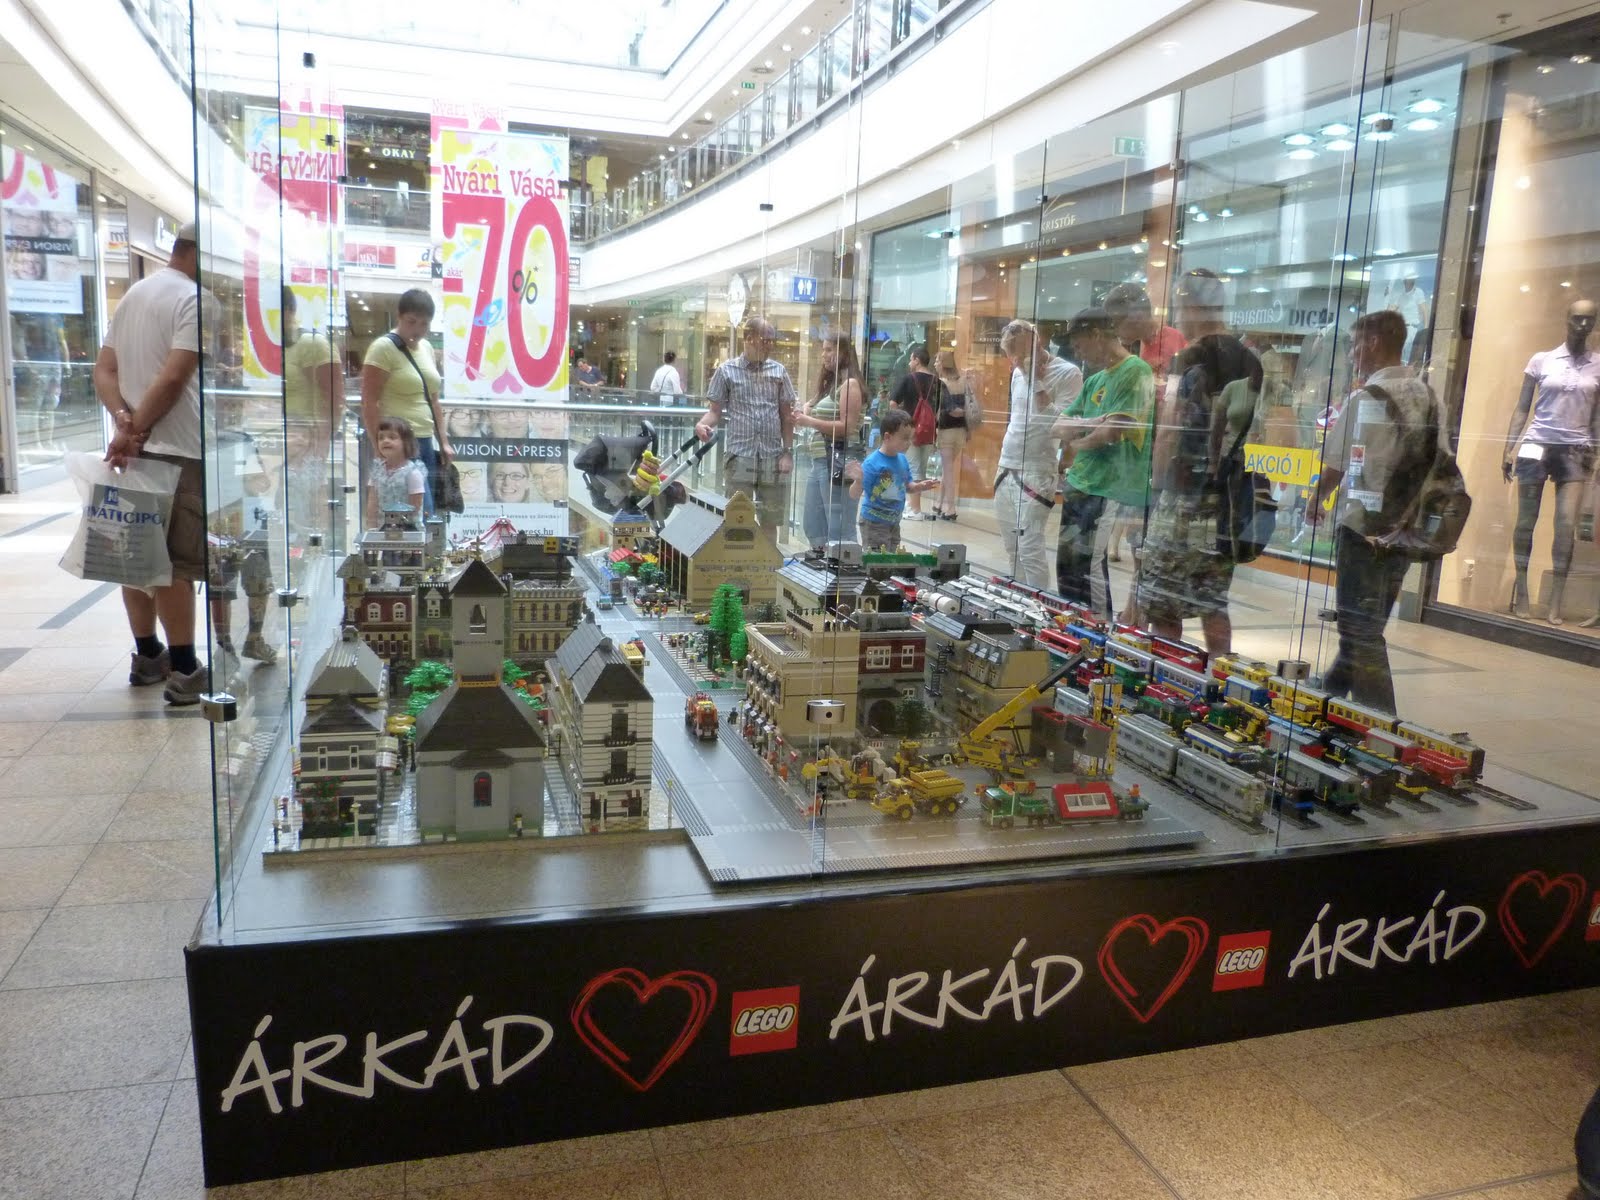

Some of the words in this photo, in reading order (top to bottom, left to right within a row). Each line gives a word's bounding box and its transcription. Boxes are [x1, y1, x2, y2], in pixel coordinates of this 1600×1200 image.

[382, 148, 416, 159] OKAY
[443, 164, 502, 195] Nyári
[1041, 214, 1077, 232] KRISTÓF
[453, 443, 501, 456] VISION
[507, 445, 562, 458] EXPRESS
[1245, 452, 1293, 476] AKCIÓ
[221, 995, 554, 1113] ÁRKÁD
[734, 1003, 797, 1036] LEGO
[830, 938, 1083, 1041] ÁRKÁD
[1217, 945, 1266, 976] LEGO
[1288, 890, 1487, 979] ÁRKÁD
